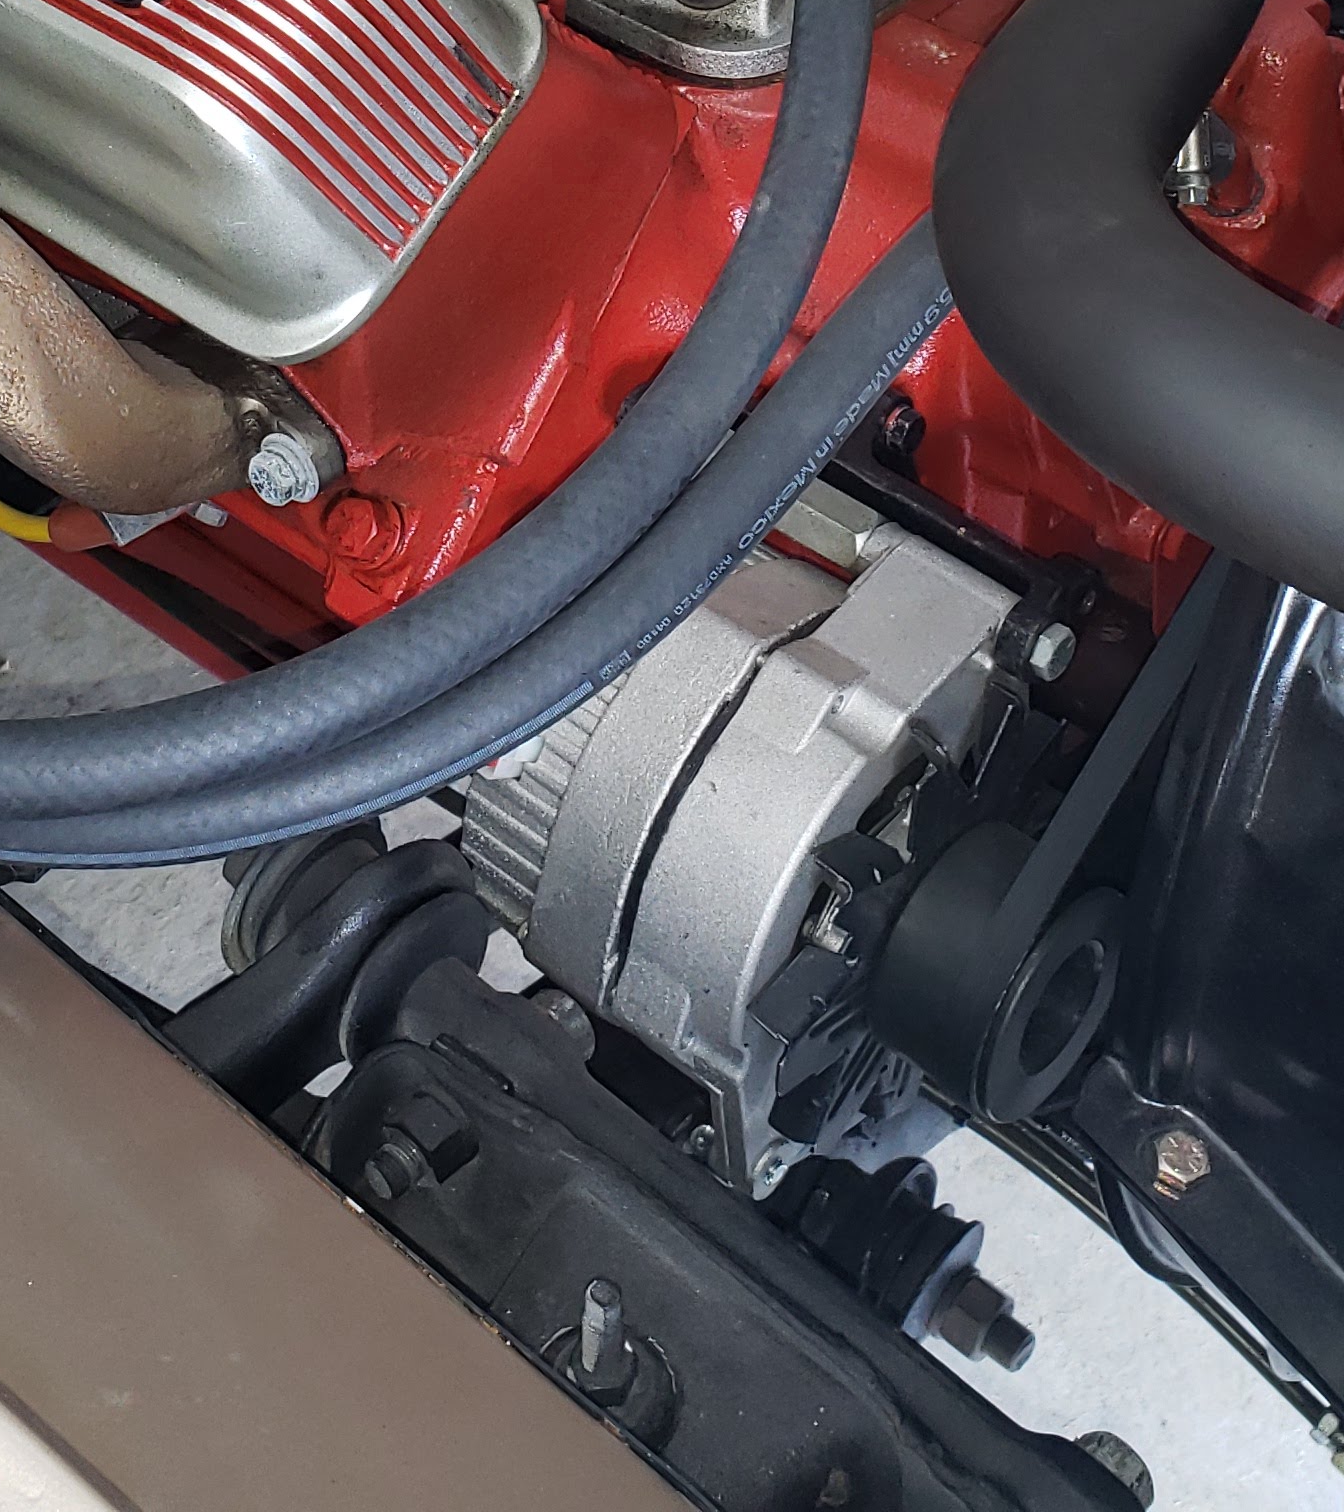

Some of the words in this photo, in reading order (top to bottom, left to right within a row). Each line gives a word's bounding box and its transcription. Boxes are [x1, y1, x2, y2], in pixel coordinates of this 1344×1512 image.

[834, 363, 892, 440] Made
[814, 434, 835, 459] in
[737, 455, 818, 550] Mexico
